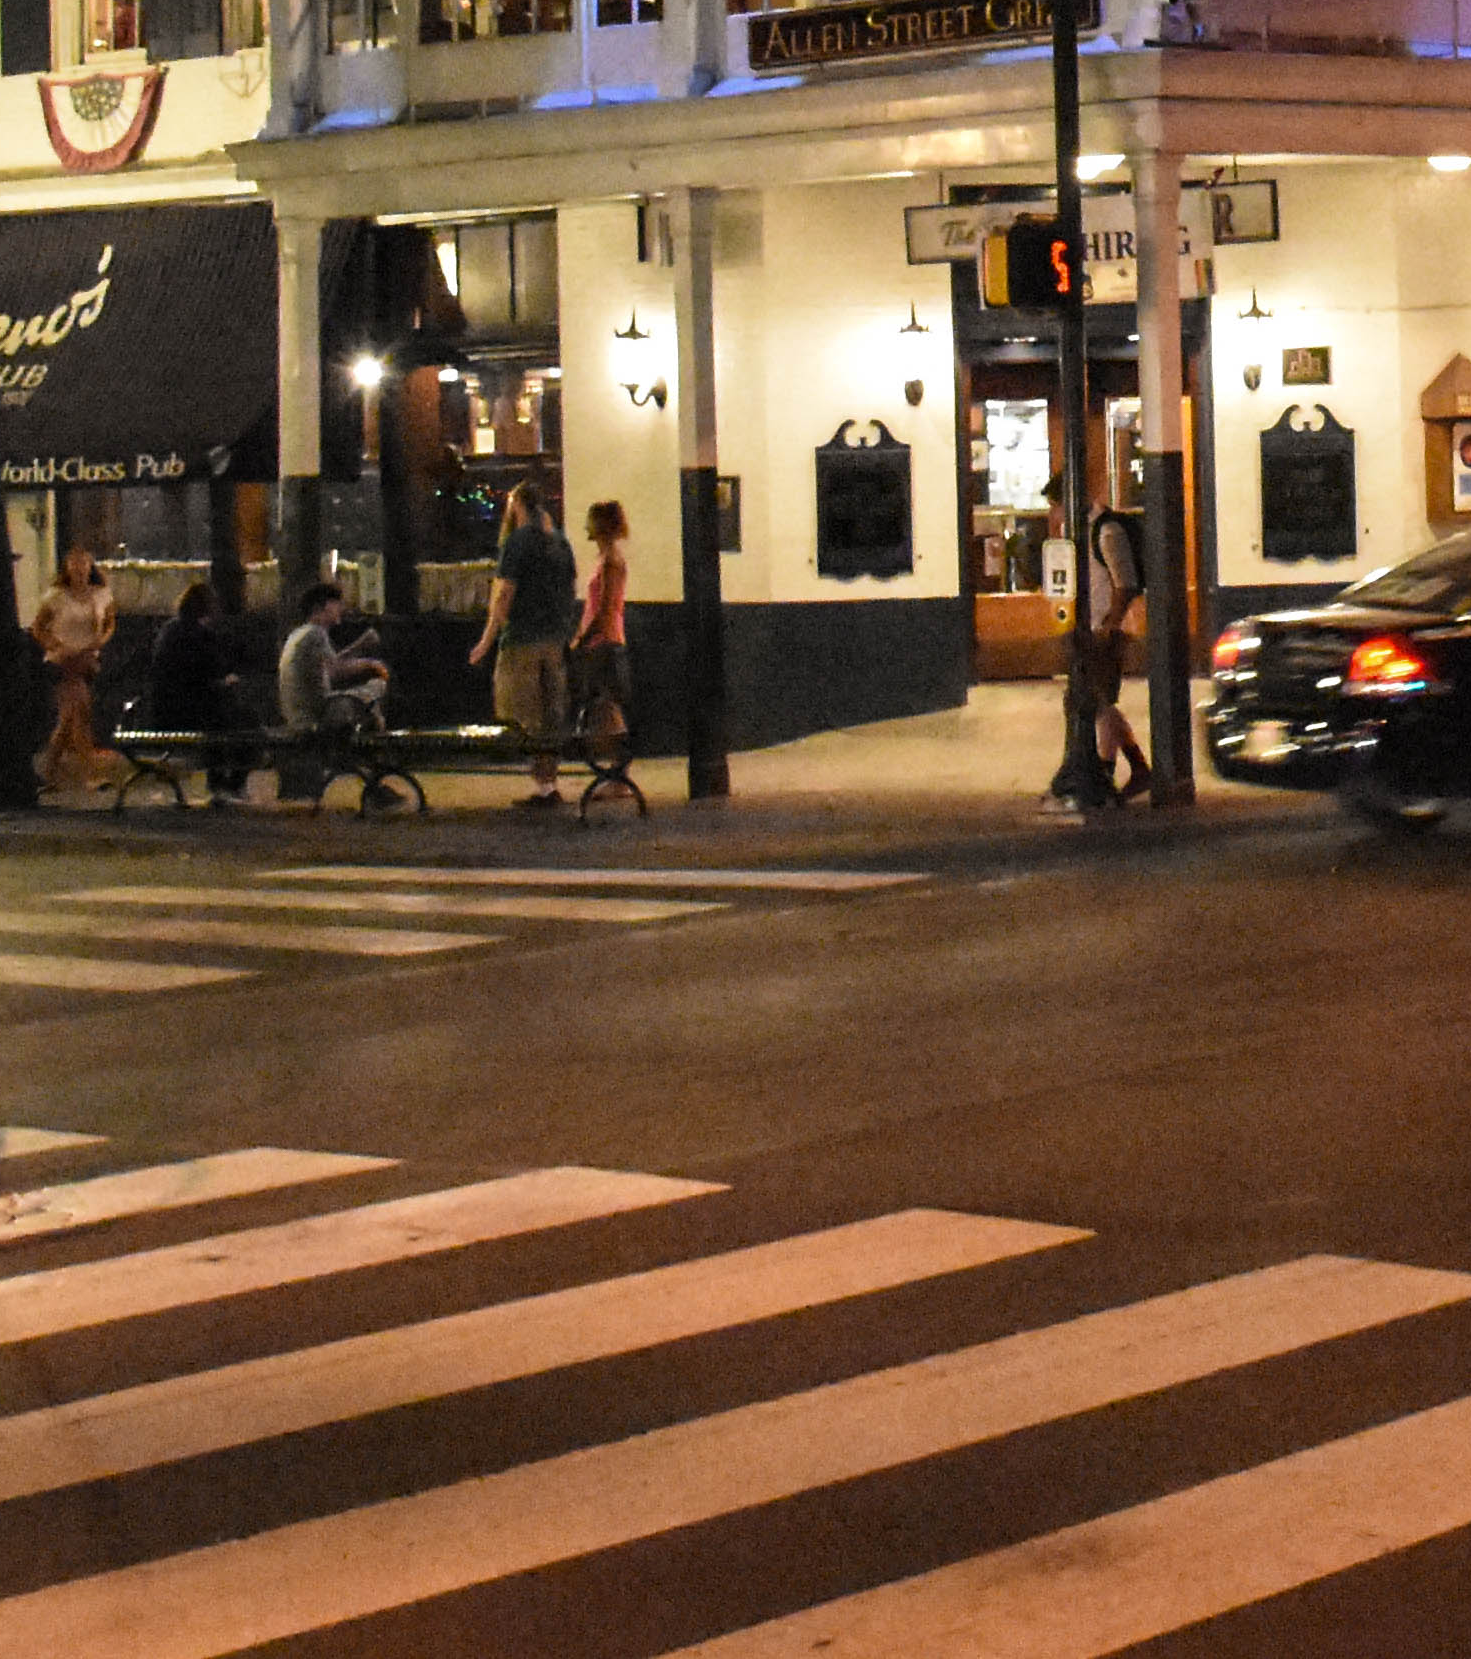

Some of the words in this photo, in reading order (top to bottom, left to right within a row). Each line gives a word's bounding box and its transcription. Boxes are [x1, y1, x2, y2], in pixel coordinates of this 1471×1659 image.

[865, 5, 971, 45] STREET
[0, 456, 127, 483] orld-Class
[135, 450, 187, 479] Pub
